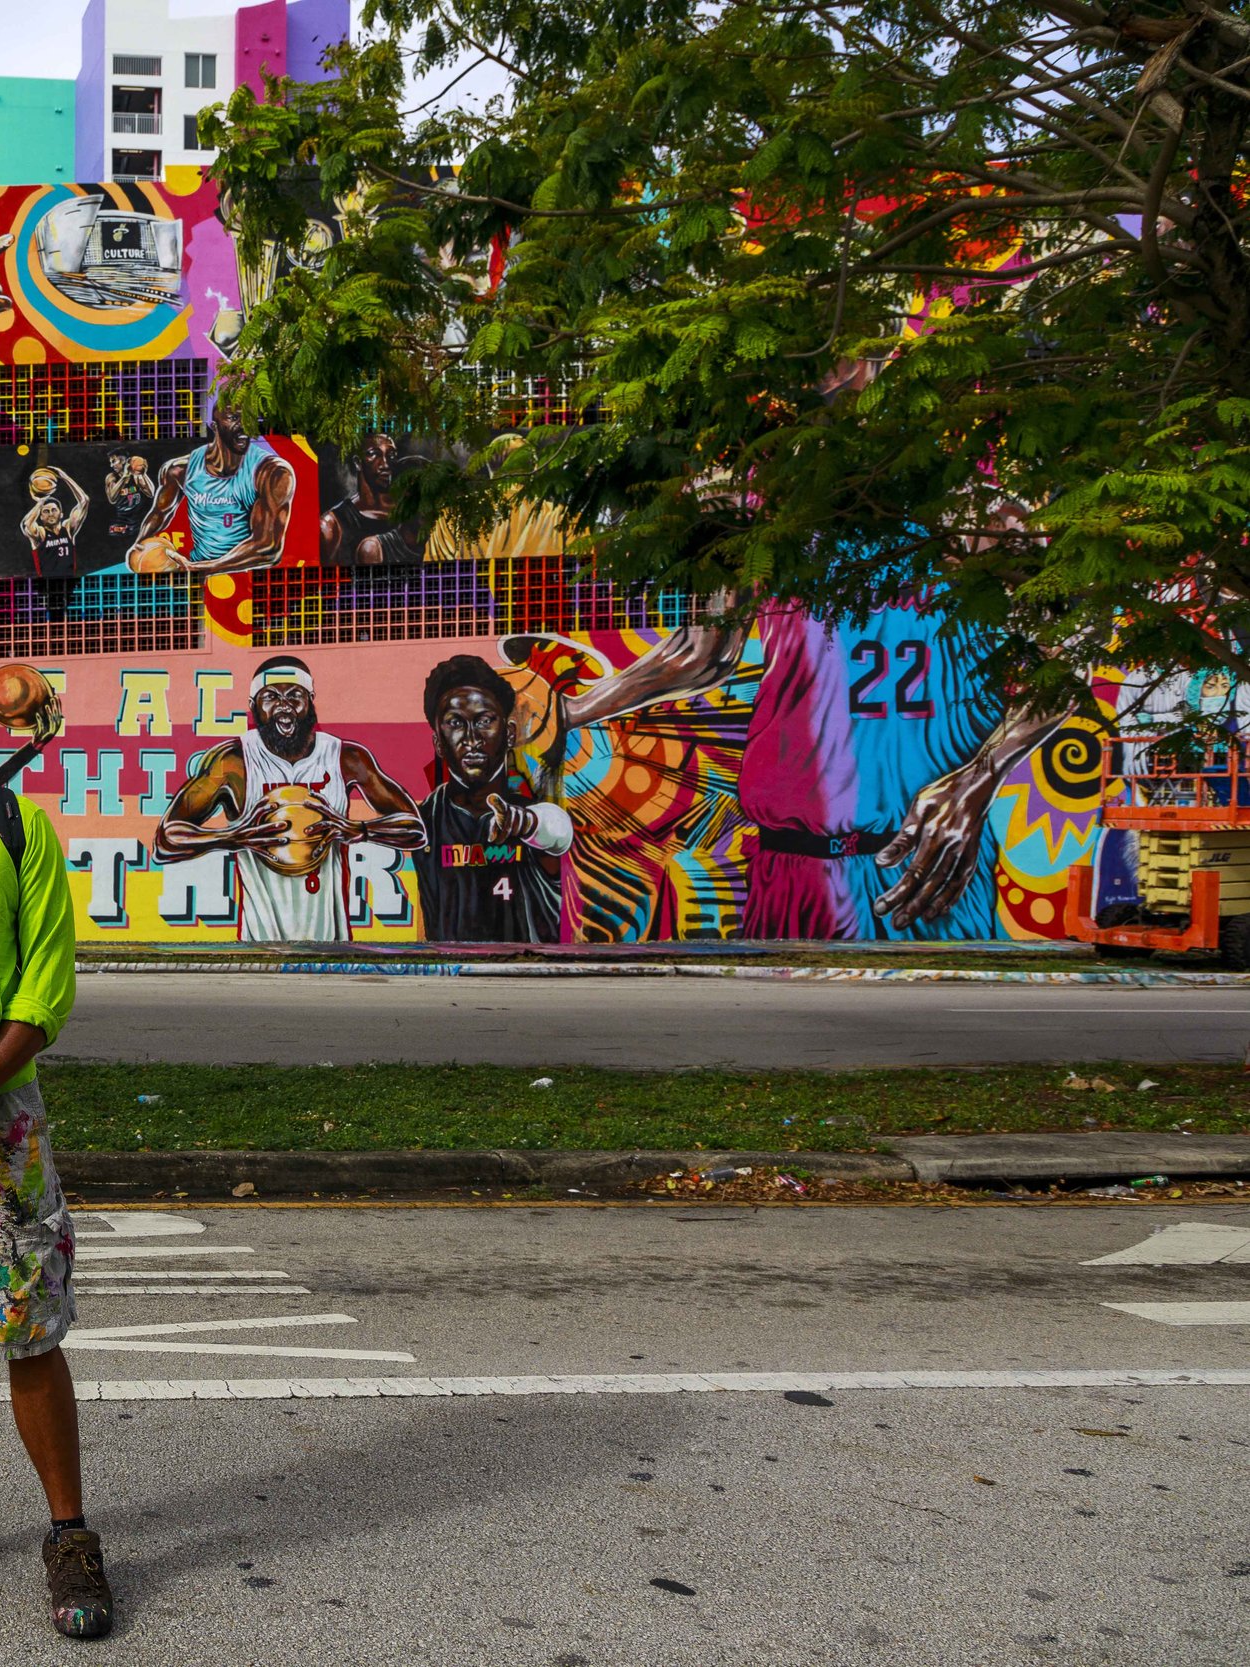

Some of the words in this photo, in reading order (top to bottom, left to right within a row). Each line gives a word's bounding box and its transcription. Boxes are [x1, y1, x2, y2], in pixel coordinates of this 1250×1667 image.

[104, 248, 145, 259] CULTURE
[223, 513, 233, 528] 0
[58, 547, 69, 556] 31
[849, 640, 935, 719] 22
[116, 669, 296, 736] AL
[493, 877, 513, 900] 4
